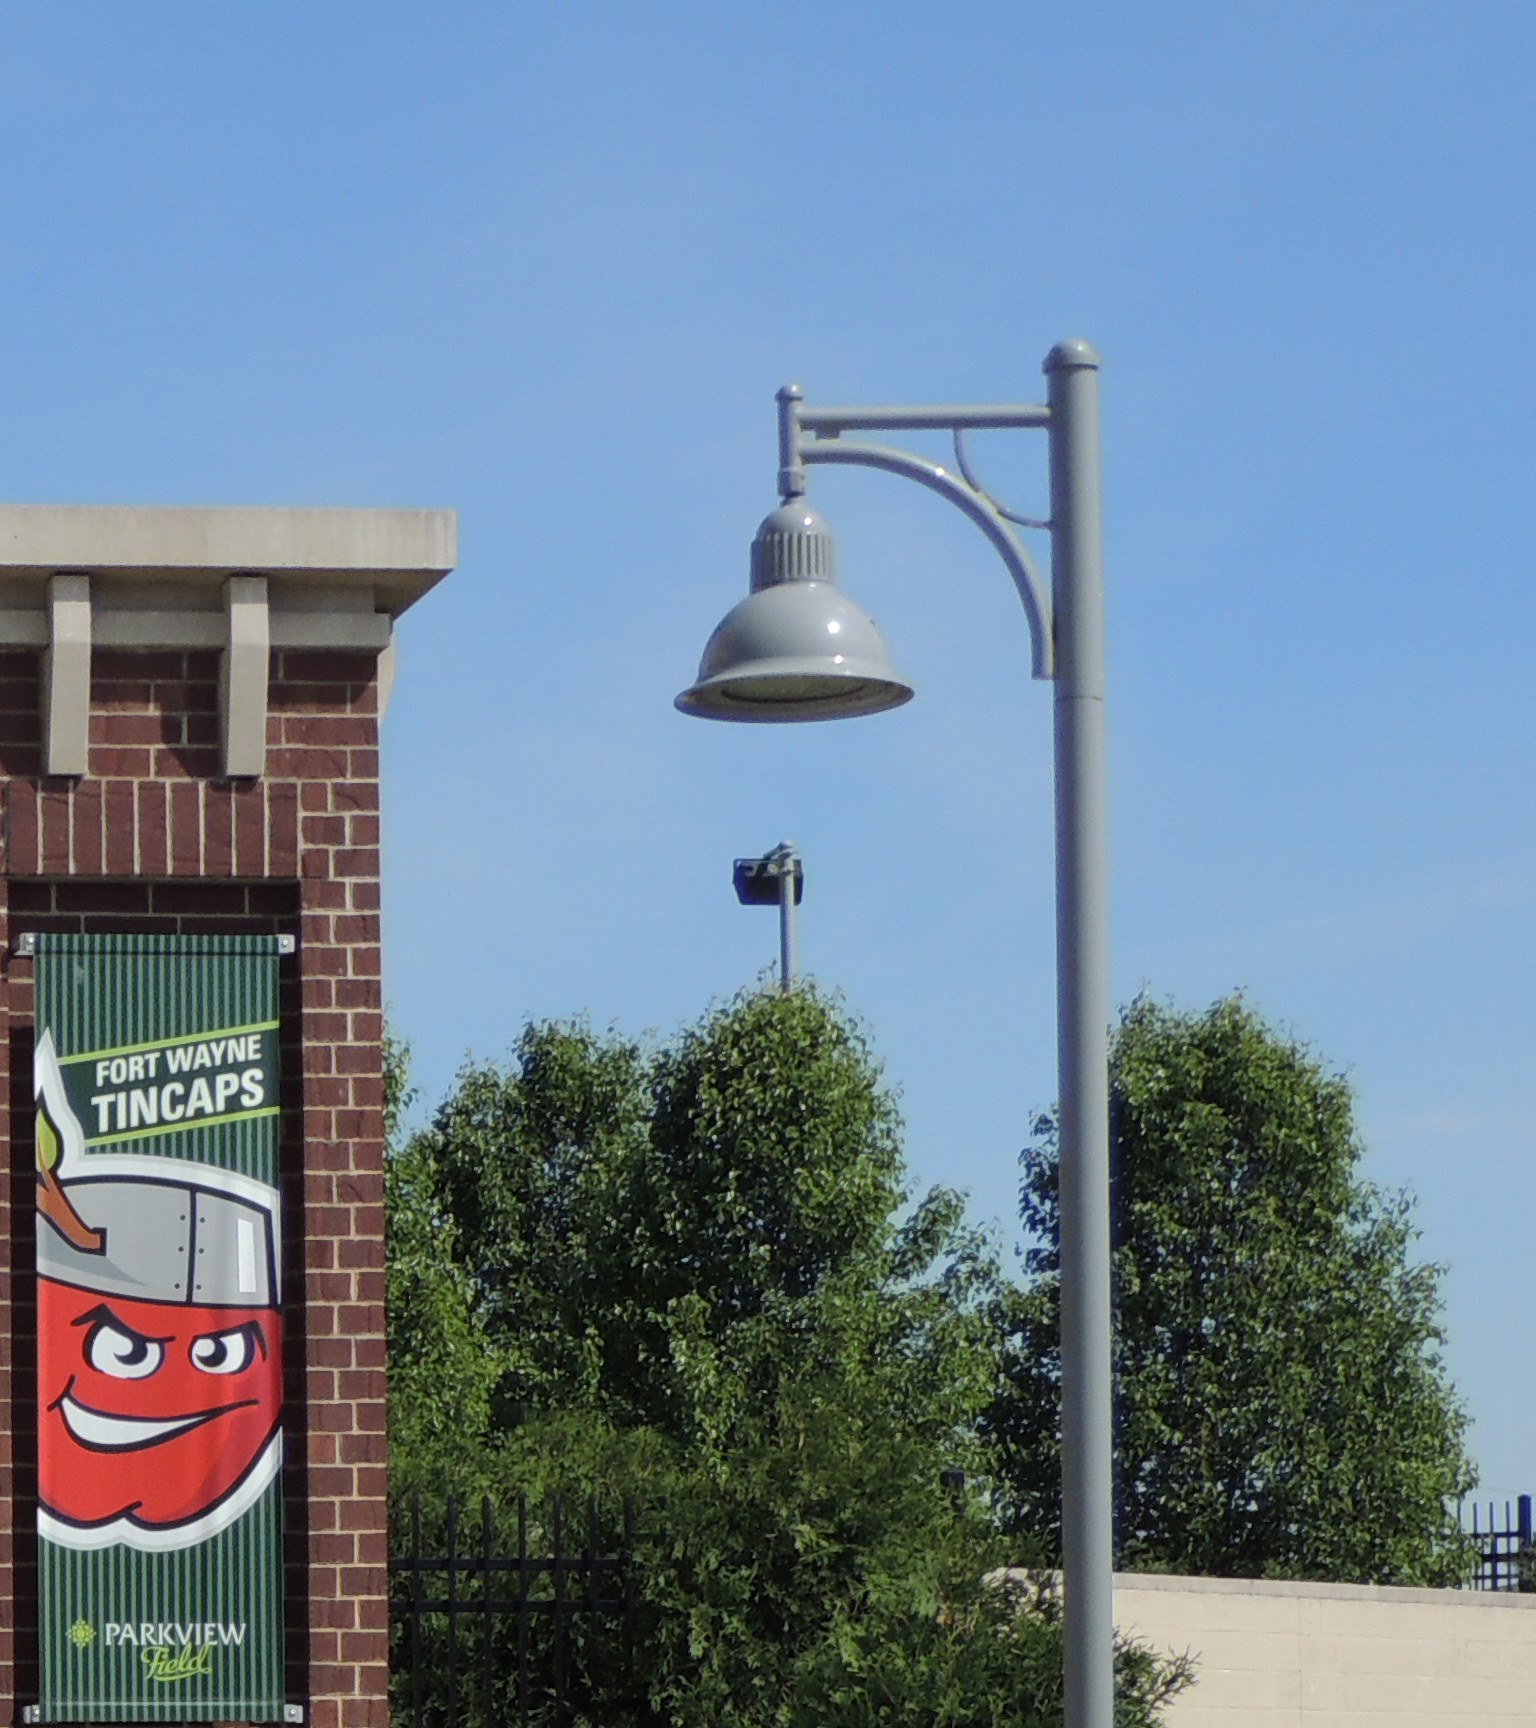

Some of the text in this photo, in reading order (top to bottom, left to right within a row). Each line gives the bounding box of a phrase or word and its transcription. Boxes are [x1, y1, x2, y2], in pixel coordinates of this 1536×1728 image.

[95, 1034, 262, 1088] FORT WAYNE
[91, 1068, 264, 1133] TINCAPS
[105, 1622, 247, 1646] PARKVIEW
[140, 1640, 213, 1682] Field
